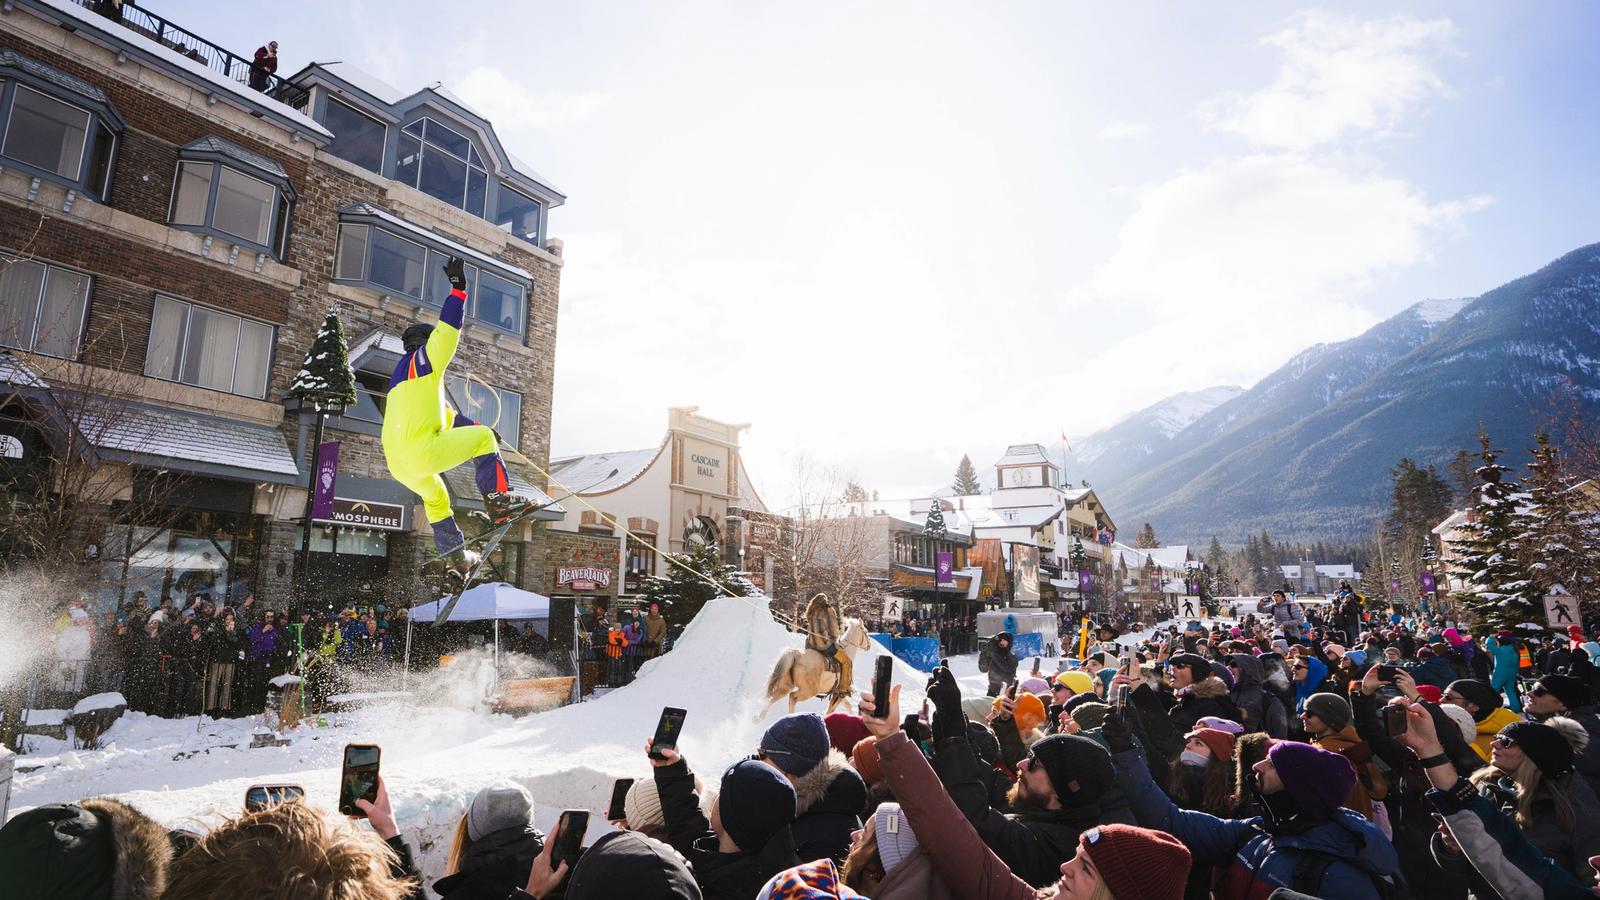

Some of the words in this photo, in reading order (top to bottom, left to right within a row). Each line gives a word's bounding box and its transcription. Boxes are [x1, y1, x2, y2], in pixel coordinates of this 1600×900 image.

[691, 454, 720, 468] CASCADE
[697, 465, 714, 477] HALL
[331, 511, 398, 526] MOSPHERE
[559, 567, 610, 585] BEAVERTAILS
